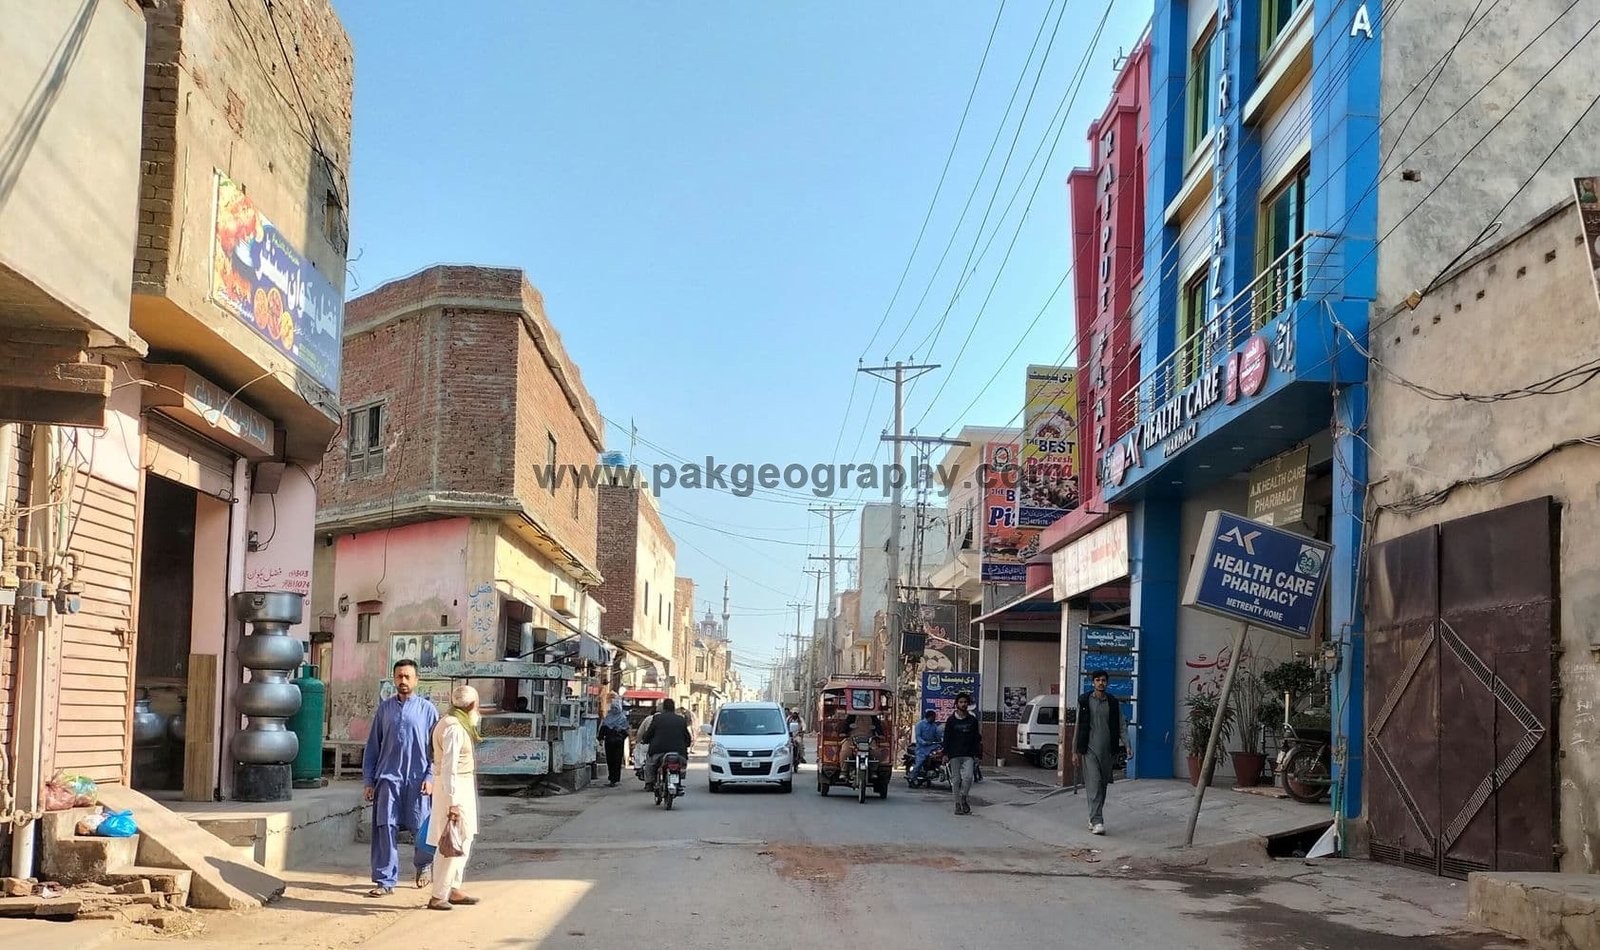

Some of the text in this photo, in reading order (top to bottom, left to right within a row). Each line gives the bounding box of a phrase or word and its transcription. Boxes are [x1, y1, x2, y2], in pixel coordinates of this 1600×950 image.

[1350, 4, 1373, 38] A
[1143, 395, 1183, 451] HEALTH
[1185, 365, 1222, 419] CARE
[1026, 438, 1076, 454] THE BEST
[1163, 423, 1198, 458] PHARMACY
[1025, 456, 1073, 478] Pizza
[1047, 454, 1073, 463] Fresh
[1261, 473, 1288, 491] HEALTH
[1287, 464, 1306, 481] CARE
[1254, 487, 1298, 514] PHARMACY
[1213, 553, 1316, 597] HEALTH CARE
[1221, 574, 1298, 607] PHARMACY
[1263, 605, 1284, 622] HOME
